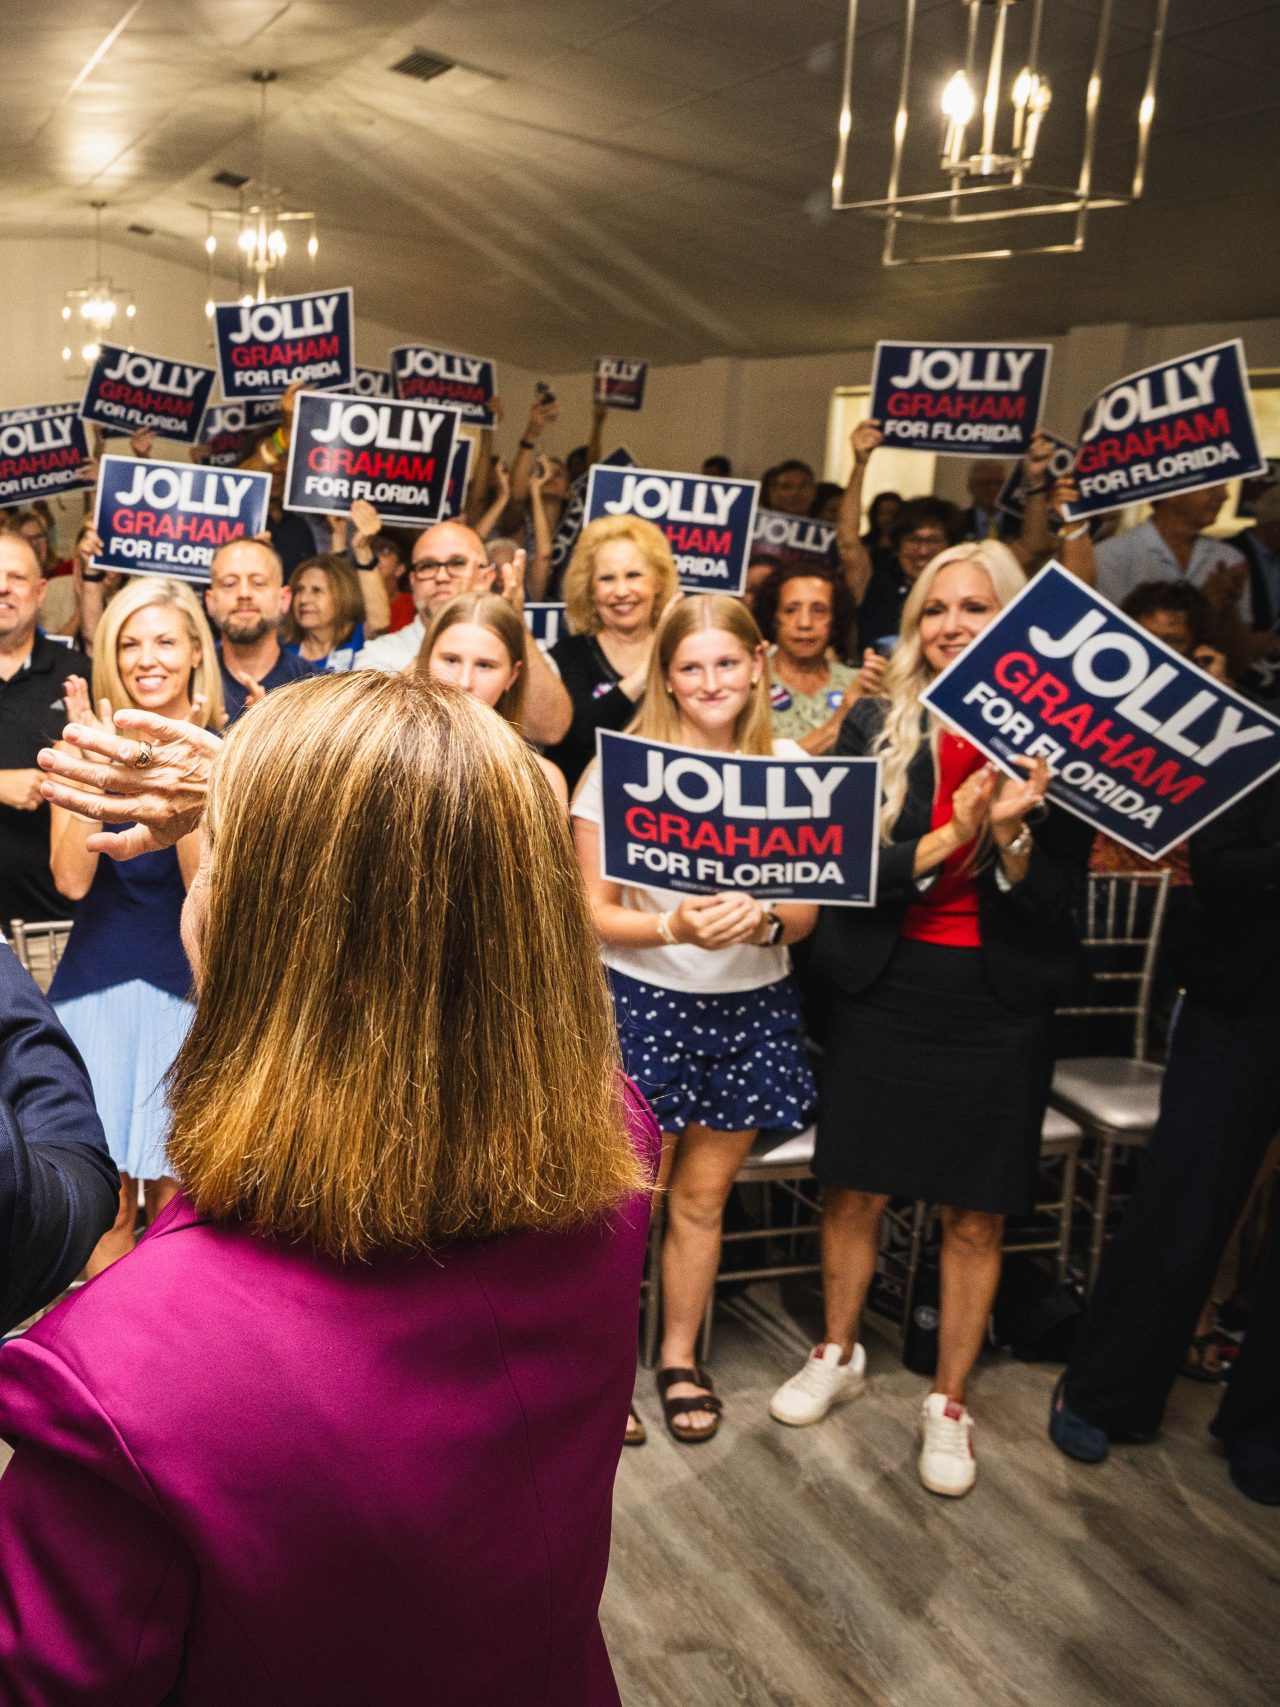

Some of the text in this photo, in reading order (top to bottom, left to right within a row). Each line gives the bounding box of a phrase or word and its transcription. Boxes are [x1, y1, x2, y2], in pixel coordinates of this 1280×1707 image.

[229, 297, 339, 344] JOLLY
[232, 336, 339, 367] GRAHAM
[397, 351, 481, 385] JOLLY
[890, 350, 1034, 391] JOLLY
[103, 353, 205, 397] JOLLY
[234, 361, 340, 387] FOR FLORIDA
[94, 400, 126, 419] FOR
[126, 409, 188, 432] FLORIDA
[98, 380, 193, 417] GRAHAM
[887, 392, 1026, 421] GRAHAM
[1082, 355, 1220, 441] JOLLY
[310, 402, 445, 453] JOLLY
[884, 420, 1023, 443] FOR FLORIDA
[1077, 407, 1230, 473] GRAHAM
[307, 447, 435, 482] GRAHAM
[1079, 470, 1129, 498] FOR
[1130, 441, 1241, 486] FLORIDA
[115, 466, 253, 517] JOLLY
[305, 476, 350, 498] FOR
[352, 481, 431, 506] FLORIDA
[604, 475, 742, 526] JOLLY
[112, 508, 245, 545] GRAHAM
[109, 537, 213, 566] FOR FLORI
[671, 555, 729, 578] ORIDA
[1029, 608, 1275, 767] JOLLY
[994, 651, 1206, 804] GRAHAM
[963, 682, 1035, 745] FOR
[1025, 733, 1164, 829] FLORIDA
[623, 750, 850, 820] JOLLY
[625, 806, 843, 858] GRAHAM
[627, 843, 845, 887] FOR FLORIDA
